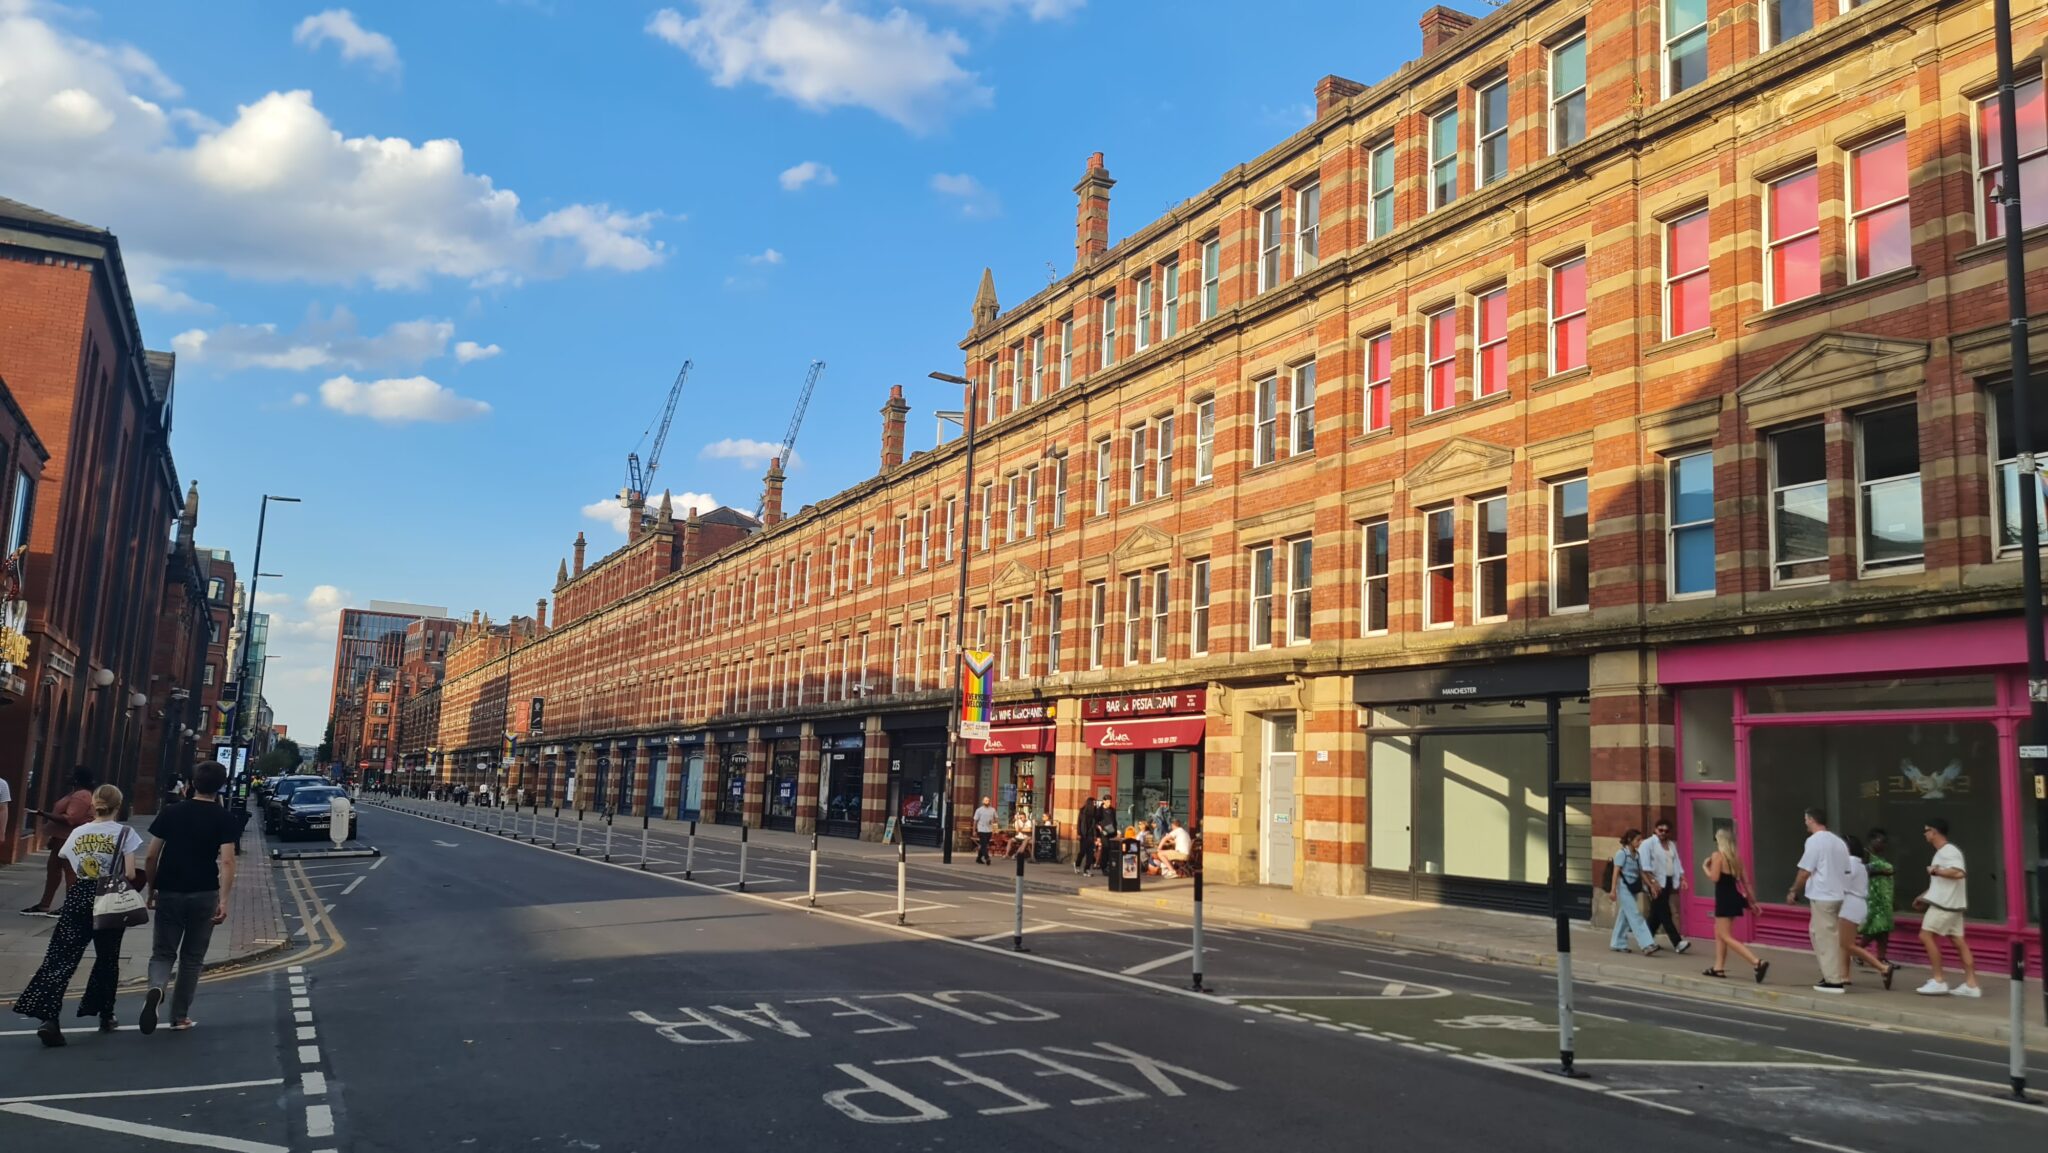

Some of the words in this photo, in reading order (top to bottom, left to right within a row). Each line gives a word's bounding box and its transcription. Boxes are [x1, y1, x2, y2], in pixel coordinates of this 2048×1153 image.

[1442, 687, 1477, 695] MANCHESTER
[965, 700, 991, 709] WELCOME
[1106, 700, 1120, 712] BAR
[780, 788, 791, 797] SALE
[75, 832, 115, 846] CIRCA
[72, 842, 117, 856] WAVES
[629, 990, 1061, 1045] CLEAR
[822, 1041, 1242, 1124] KEEP
